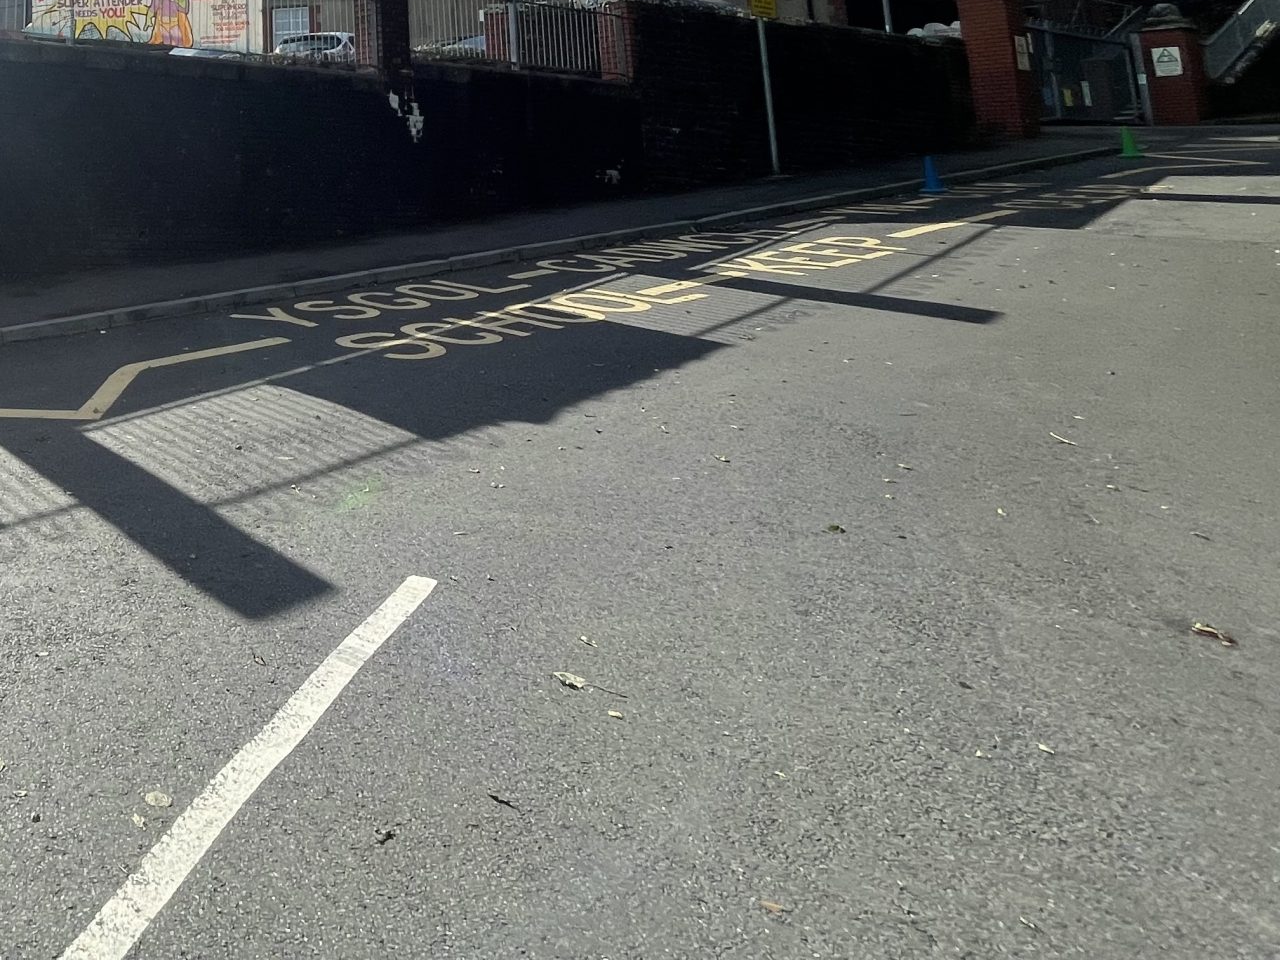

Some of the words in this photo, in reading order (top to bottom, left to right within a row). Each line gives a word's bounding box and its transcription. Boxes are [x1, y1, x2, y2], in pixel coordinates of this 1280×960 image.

[75, 9, 97, 18] NEEDS
[99, 7, 126, 19] YOU!
[229, 279, 531, 328] YSGOL
[536, 229, 799, 273] CADWCH
[335, 287, 710, 360] SCHOOL
[717, 234, 907, 276] KEEP
